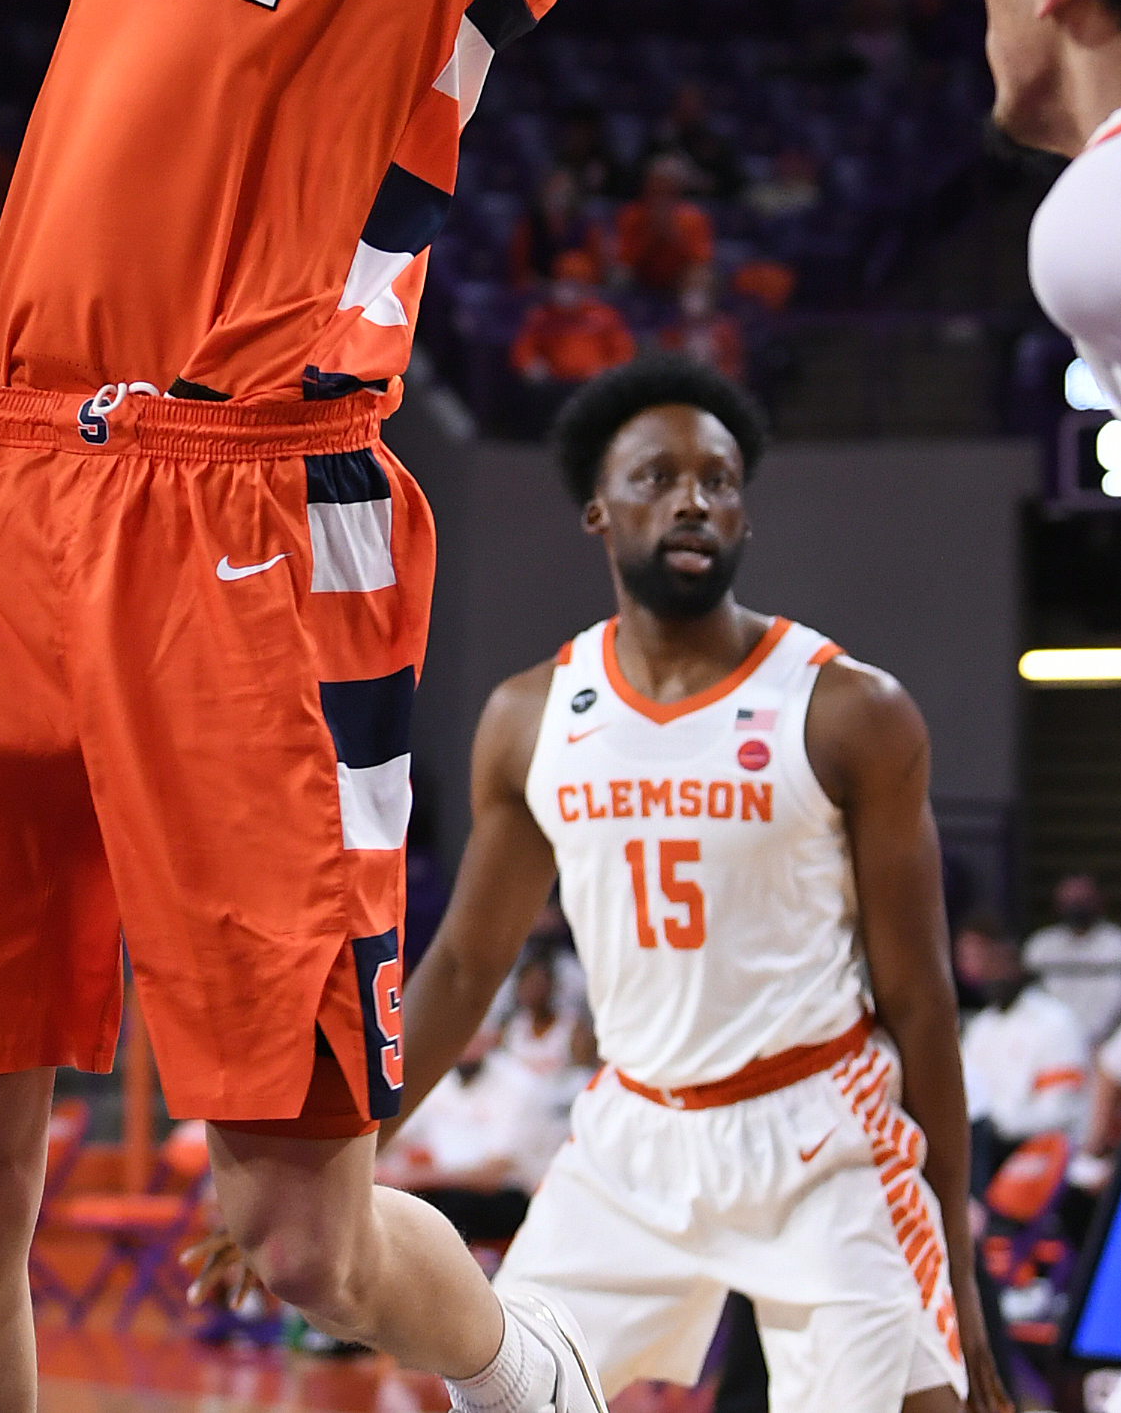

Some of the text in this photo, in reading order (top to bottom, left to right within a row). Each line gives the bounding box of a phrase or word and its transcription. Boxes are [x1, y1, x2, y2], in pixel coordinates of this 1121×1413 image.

[77, 396, 111, 445] S
[557, 779, 773, 823] CLEMSON
[624, 839, 707, 950] 15
